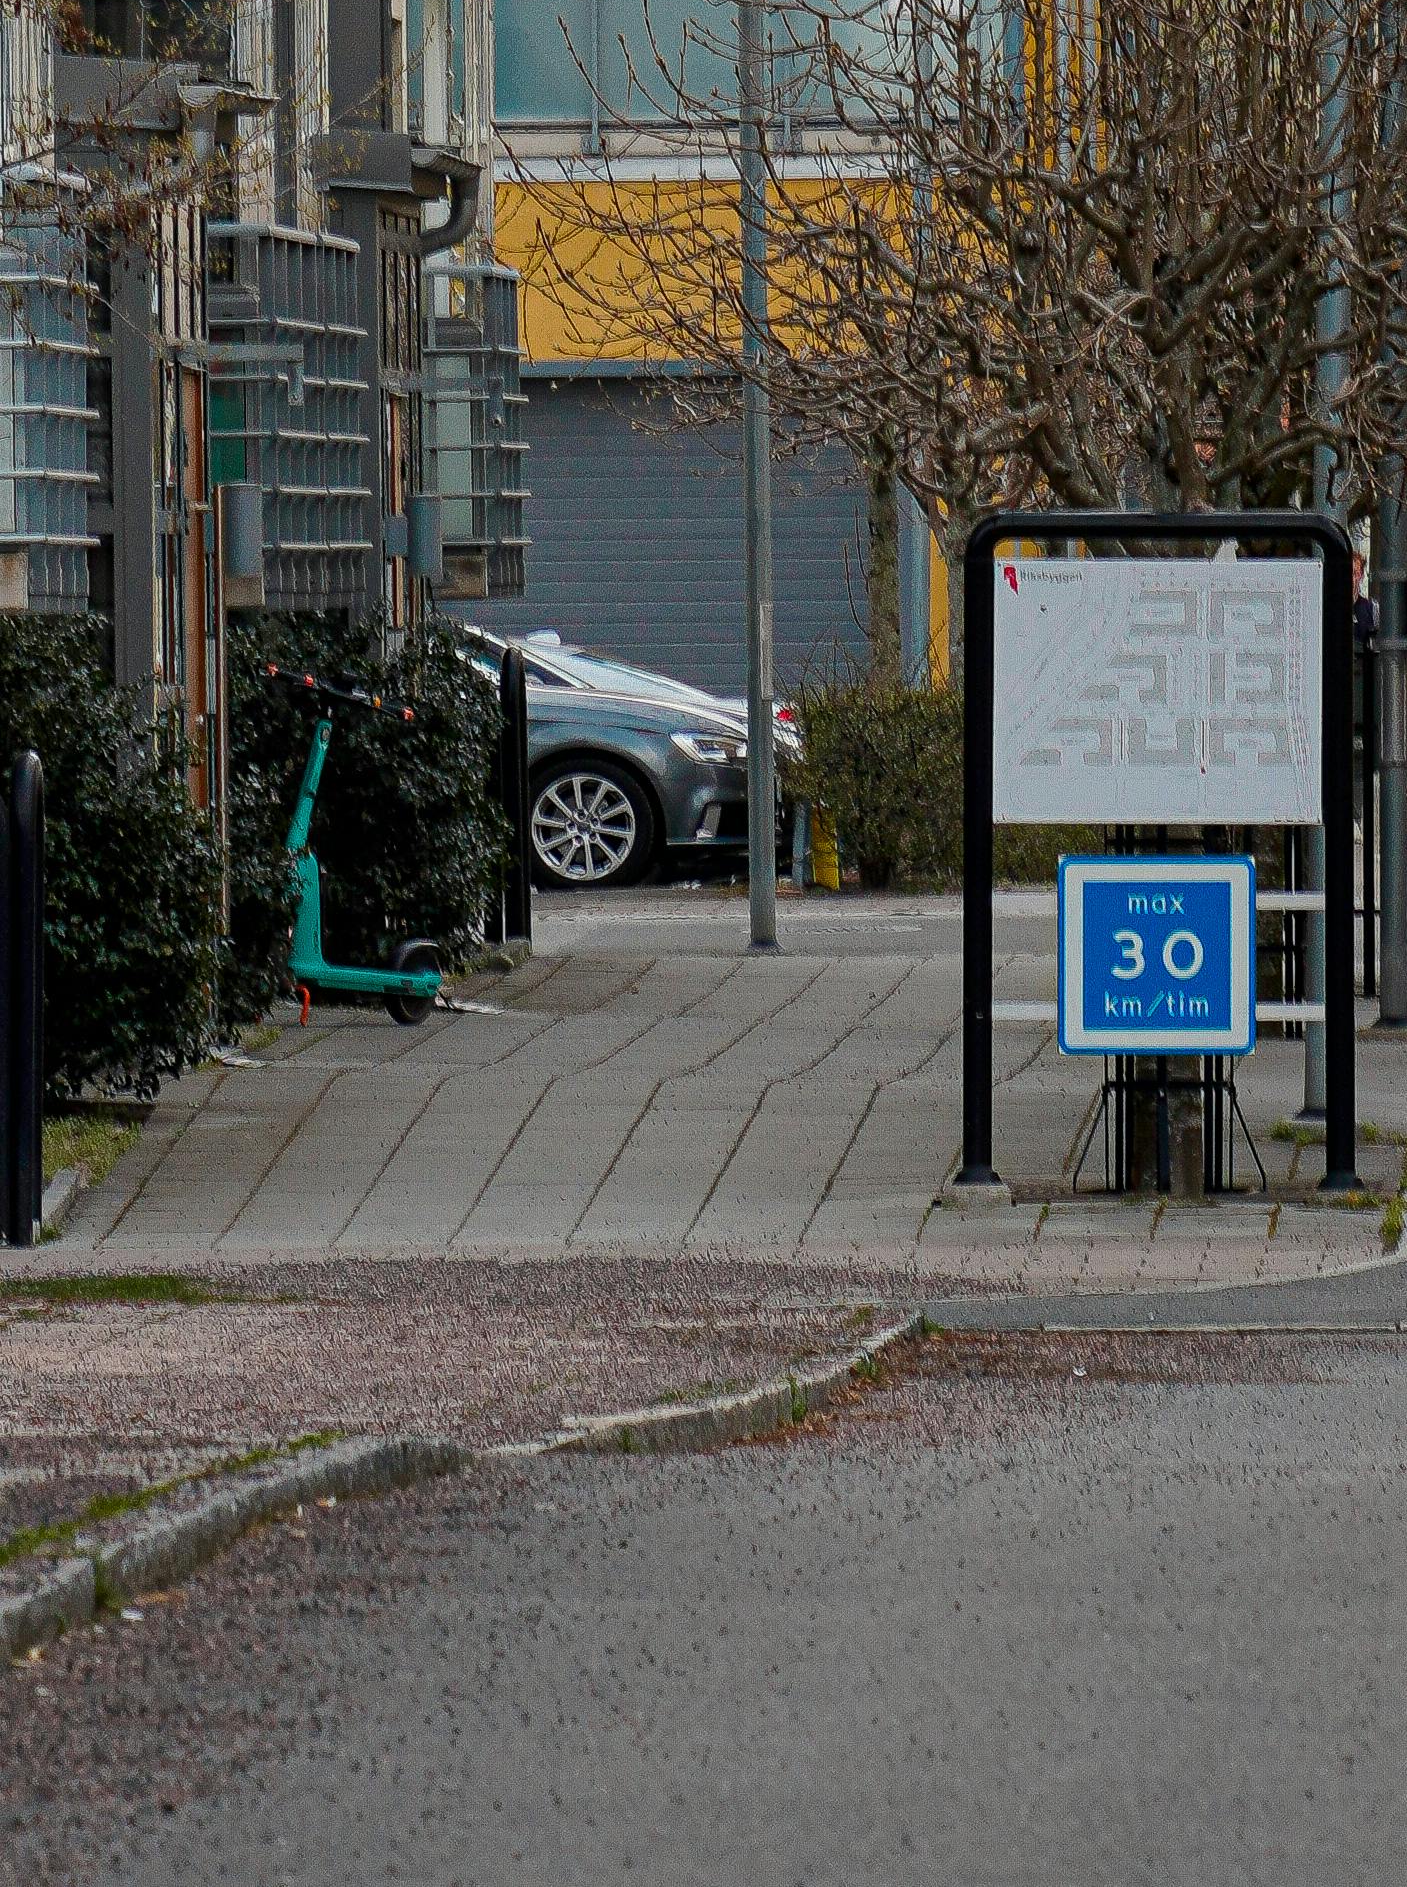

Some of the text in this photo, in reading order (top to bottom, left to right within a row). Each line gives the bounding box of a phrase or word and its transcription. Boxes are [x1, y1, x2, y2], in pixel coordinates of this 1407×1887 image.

[1127, 891, 1186, 916] max
[1110, 928, 1204, 981] 30
[1104, 990, 1210, 1019] km/tim
